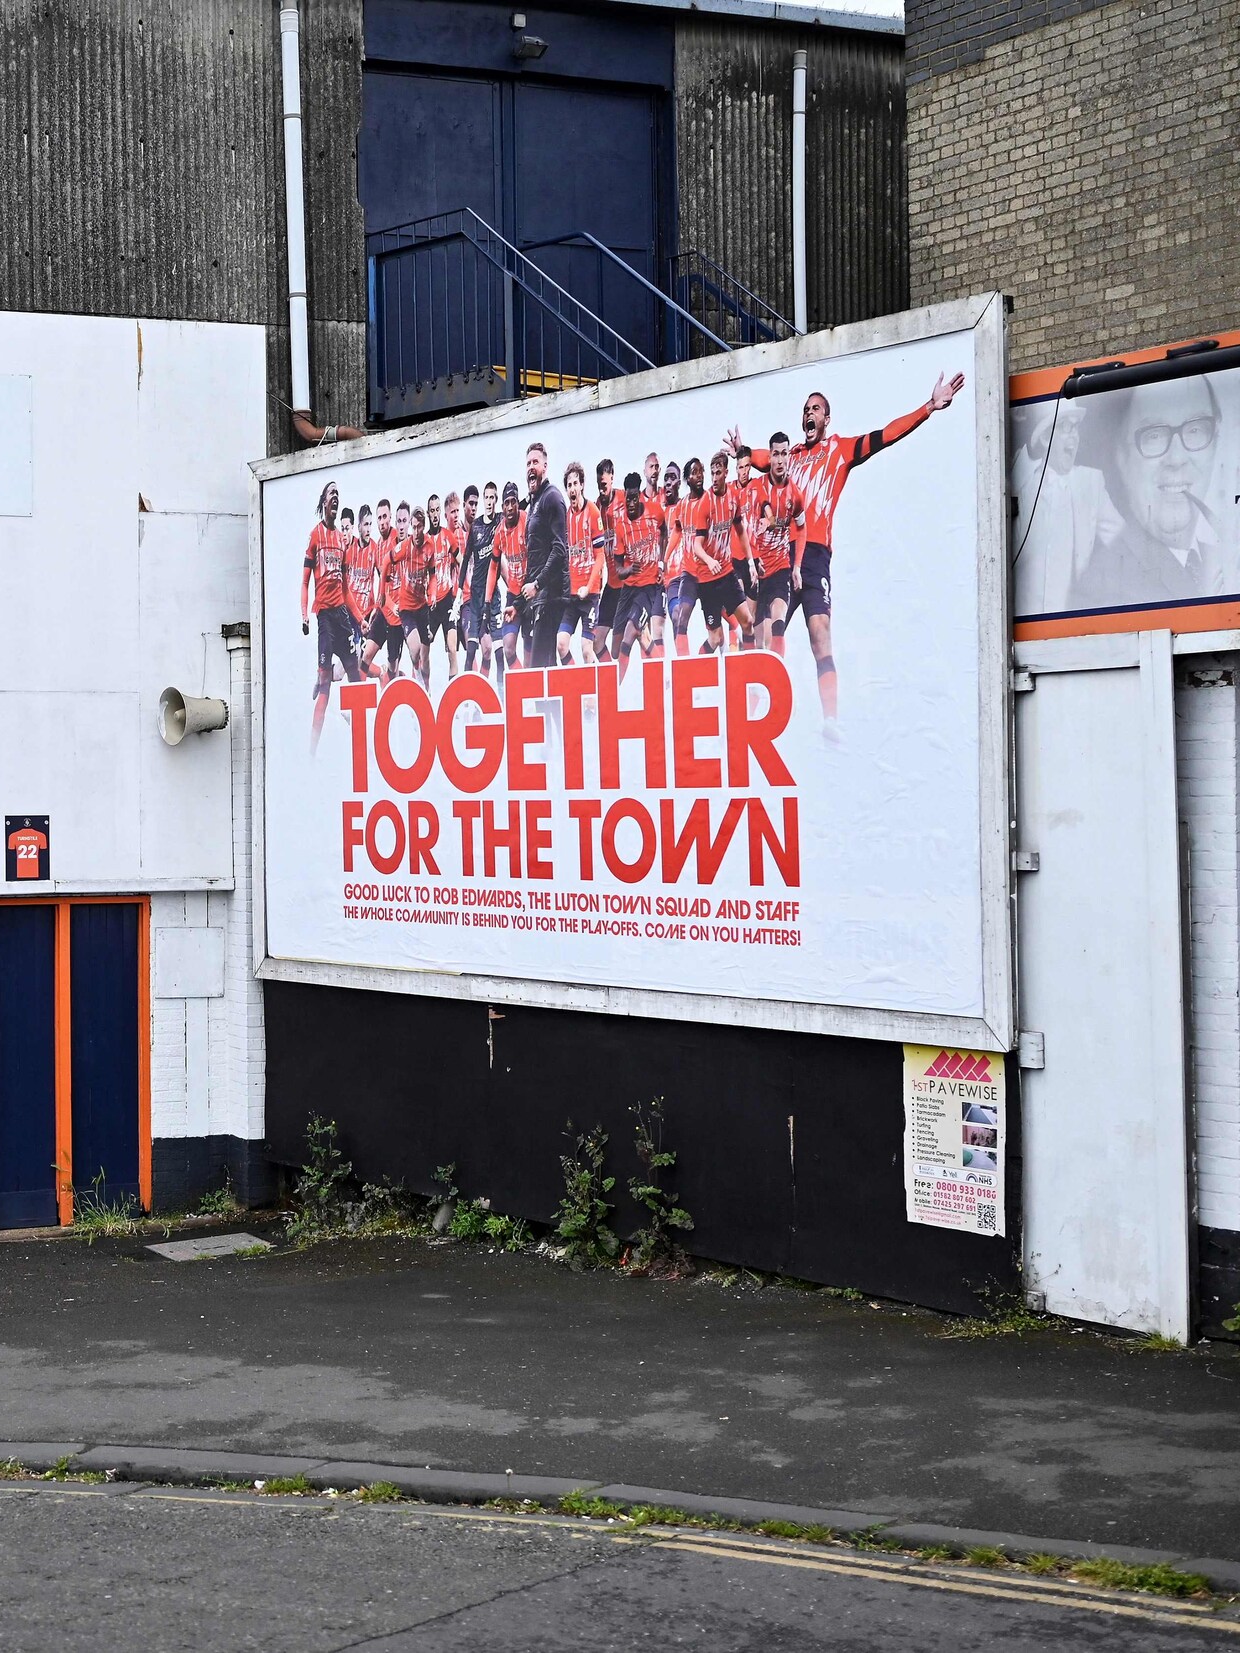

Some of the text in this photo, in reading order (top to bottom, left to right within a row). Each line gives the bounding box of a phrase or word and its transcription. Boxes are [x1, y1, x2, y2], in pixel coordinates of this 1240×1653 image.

[340, 653, 798, 794] TOGETHER
[342, 797, 800, 888] FOR THE TOWN
[17, 844, 38, 859] 22
[344, 883, 800, 922] GOOD LUCK TO ROB EDWARDS, THE LUTON TOWN SQUAD AND STAFF
[343, 906, 800, 946] THE WHOLE COMMUNITY IS BEHIND YOU FOR THE PLAY-OFFS. COME ON YOU HATTERS!
[930, 1080, 998, 1100] PAVEWISE
[917, 1155, 946, 1164] Landscaping
[936, 1182, 957, 1192] 0800
[960, 1185, 974, 1195] 933
[978, 1176, 992, 1186] NHS
[933, 1191, 951, 1200] 01582
[933, 1200, 952, 1208] 07425
